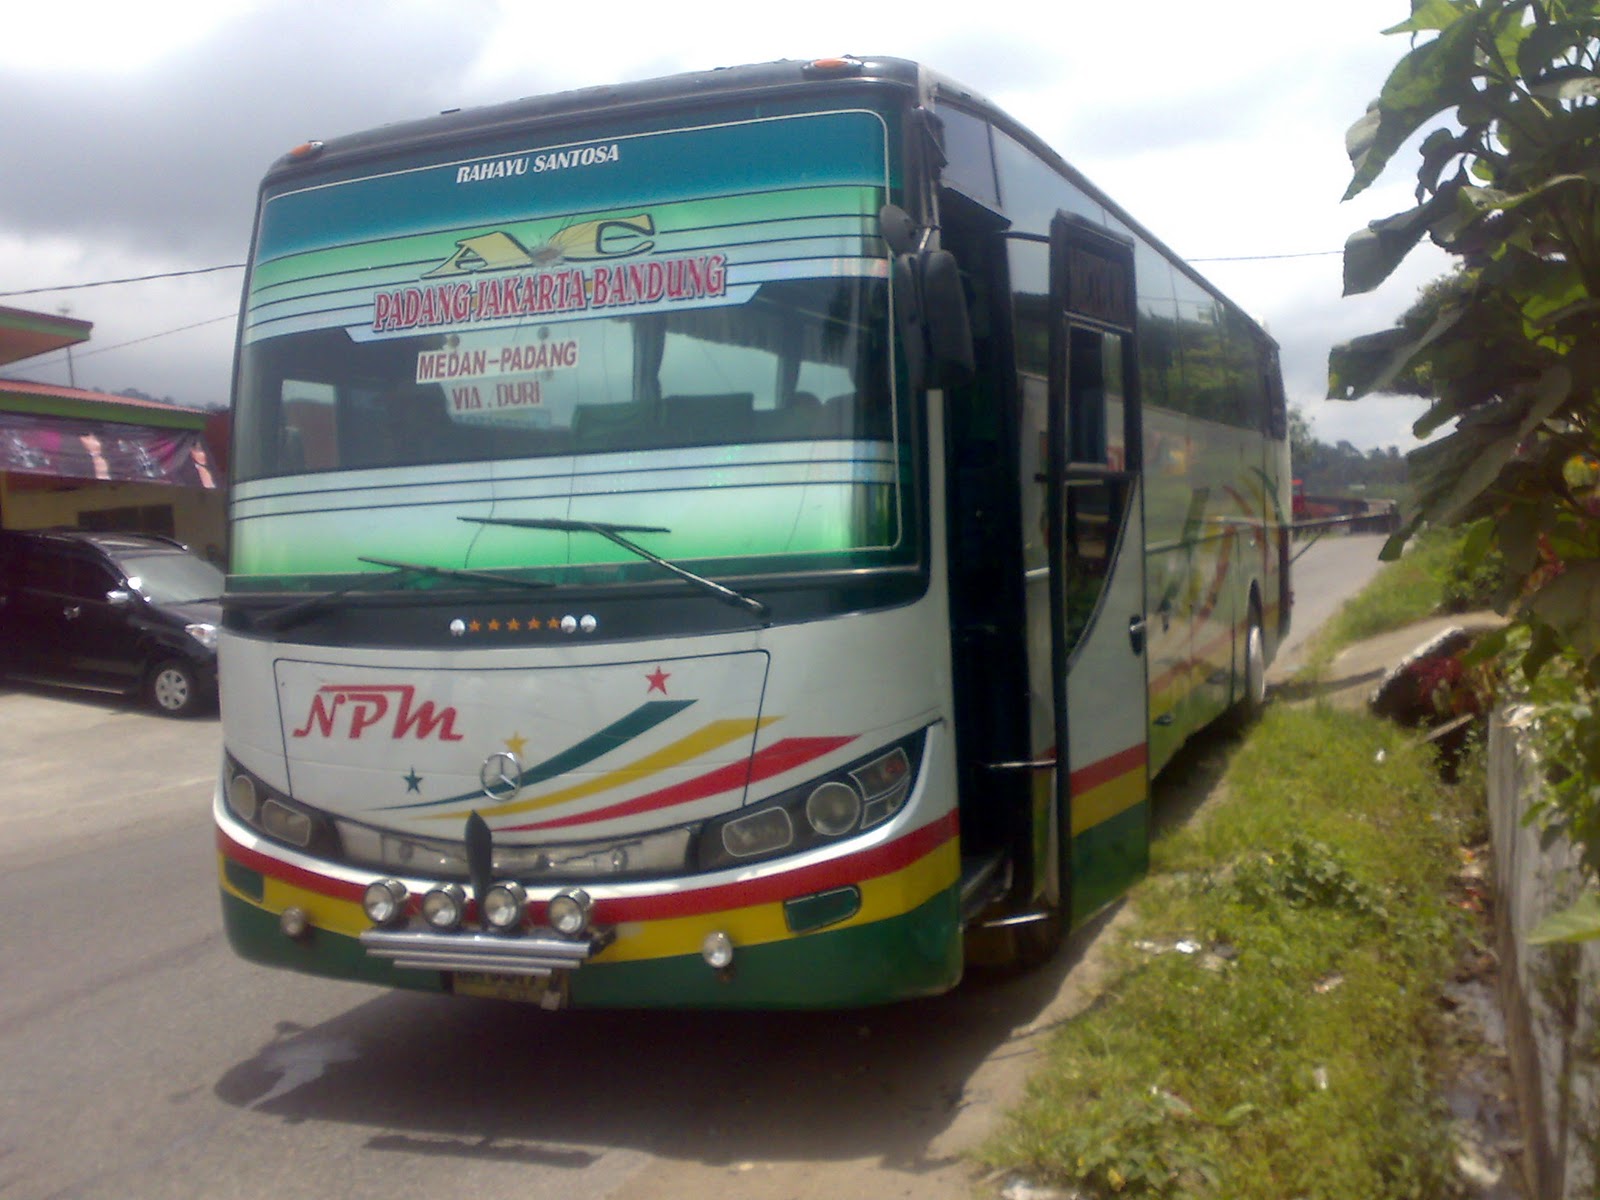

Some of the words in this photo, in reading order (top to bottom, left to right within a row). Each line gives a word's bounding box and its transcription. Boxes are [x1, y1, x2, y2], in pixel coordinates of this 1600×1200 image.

[456, 157, 529, 184] RAHAYU
[533, 144, 619, 173] SANTOSA
[373, 283, 471, 331] PADANG
[475, 271, 585, 320] JAKARTA
[593, 255, 726, 306] BANDUNG
